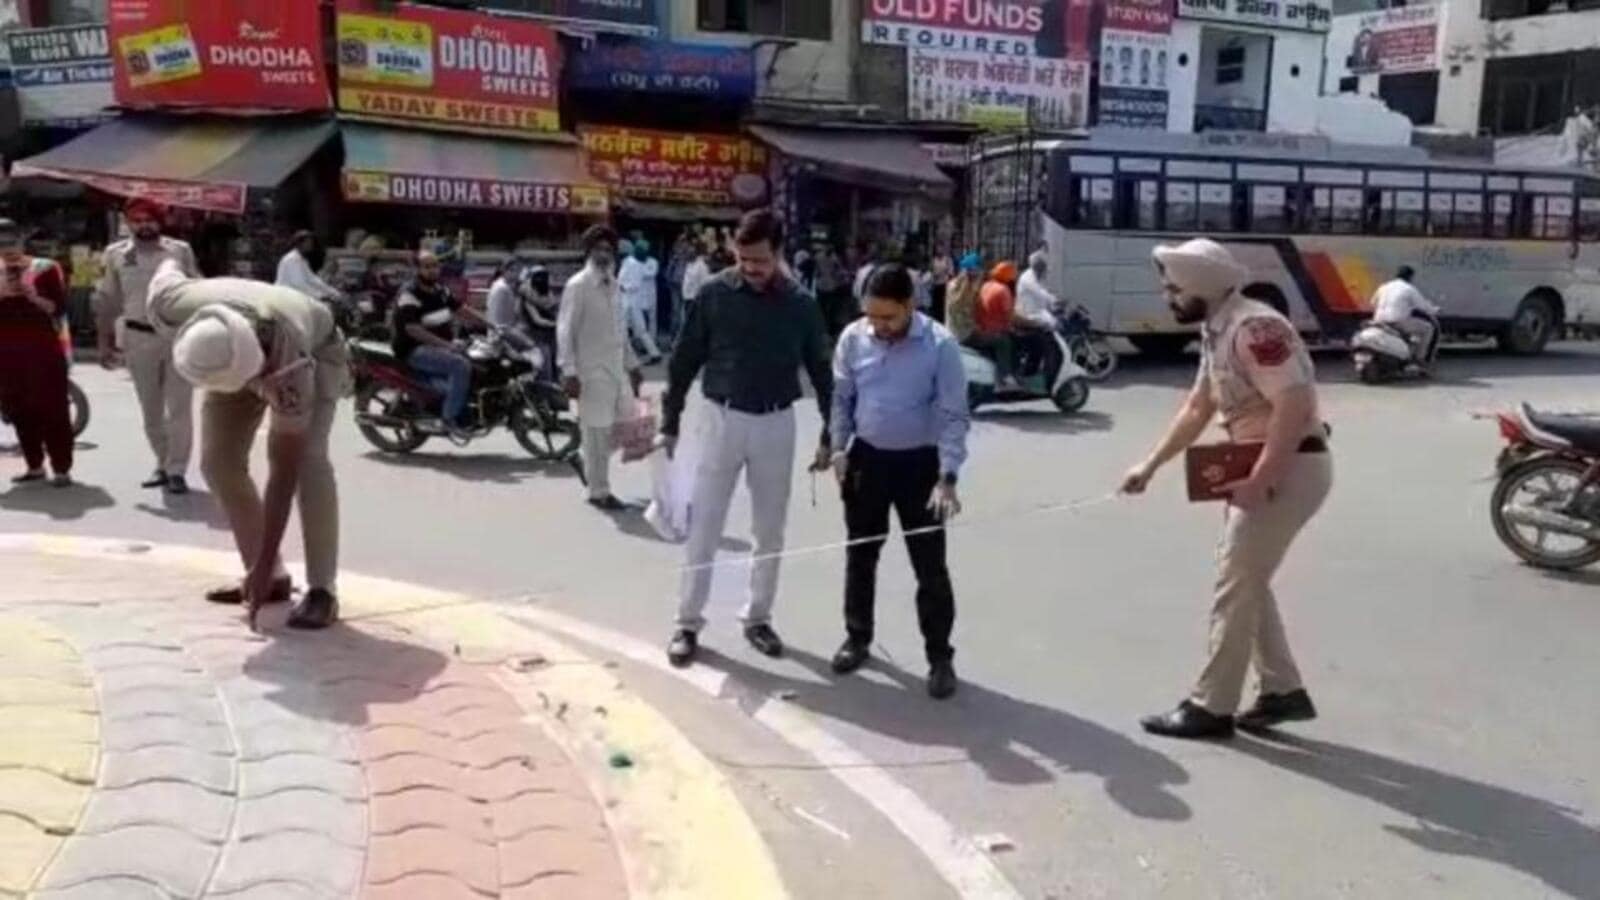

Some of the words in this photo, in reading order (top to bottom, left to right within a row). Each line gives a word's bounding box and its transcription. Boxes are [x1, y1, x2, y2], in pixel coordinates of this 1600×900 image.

[943, 0, 1043, 32] FUNDS
[872, 25, 1028, 55] REQUIRED
[209, 45, 313, 67] DHODHA
[438, 35, 549, 78] DHODHA
[261, 70, 315, 84] SWEETS
[480, 75, 550, 98] SWEETS
[357, 92, 437, 117] YADAV
[446, 101, 540, 127] SWEETS
[391, 177, 482, 204] DHODHA
[489, 184, 570, 210] SWEETS
